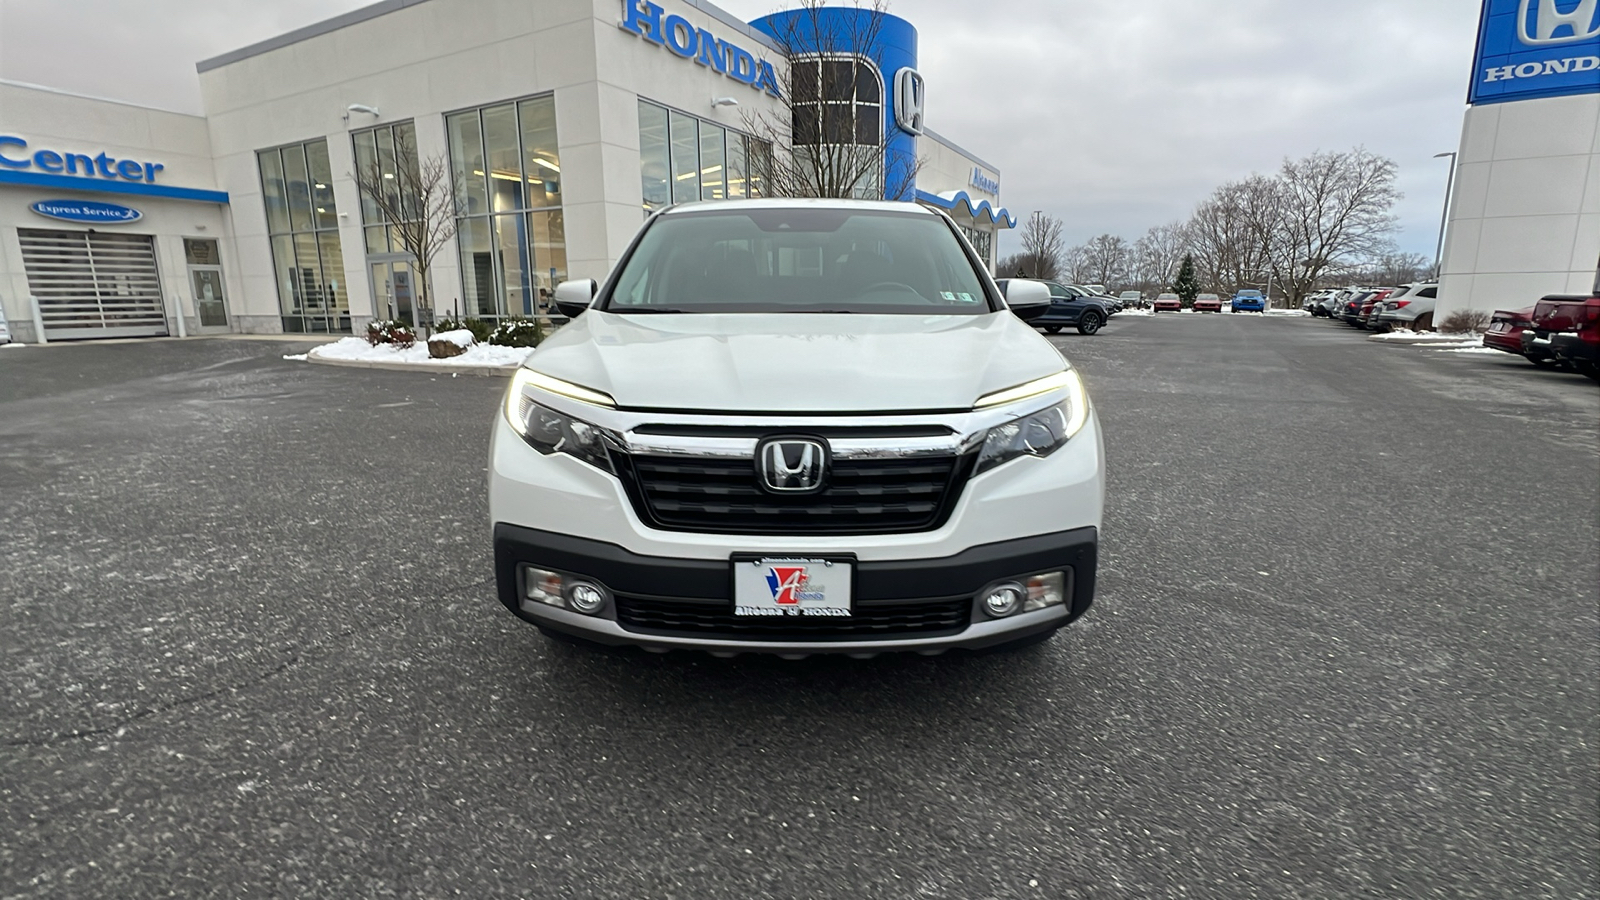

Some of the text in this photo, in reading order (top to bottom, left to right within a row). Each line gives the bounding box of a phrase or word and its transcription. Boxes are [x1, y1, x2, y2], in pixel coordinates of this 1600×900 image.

[620, 0, 780, 98] HONDA
[1483, 56, 1600, 83] HOND
[0, 136, 164, 182] Center
[38, 203, 121, 217] Express Service
[803, 607, 852, 617] HONDA
